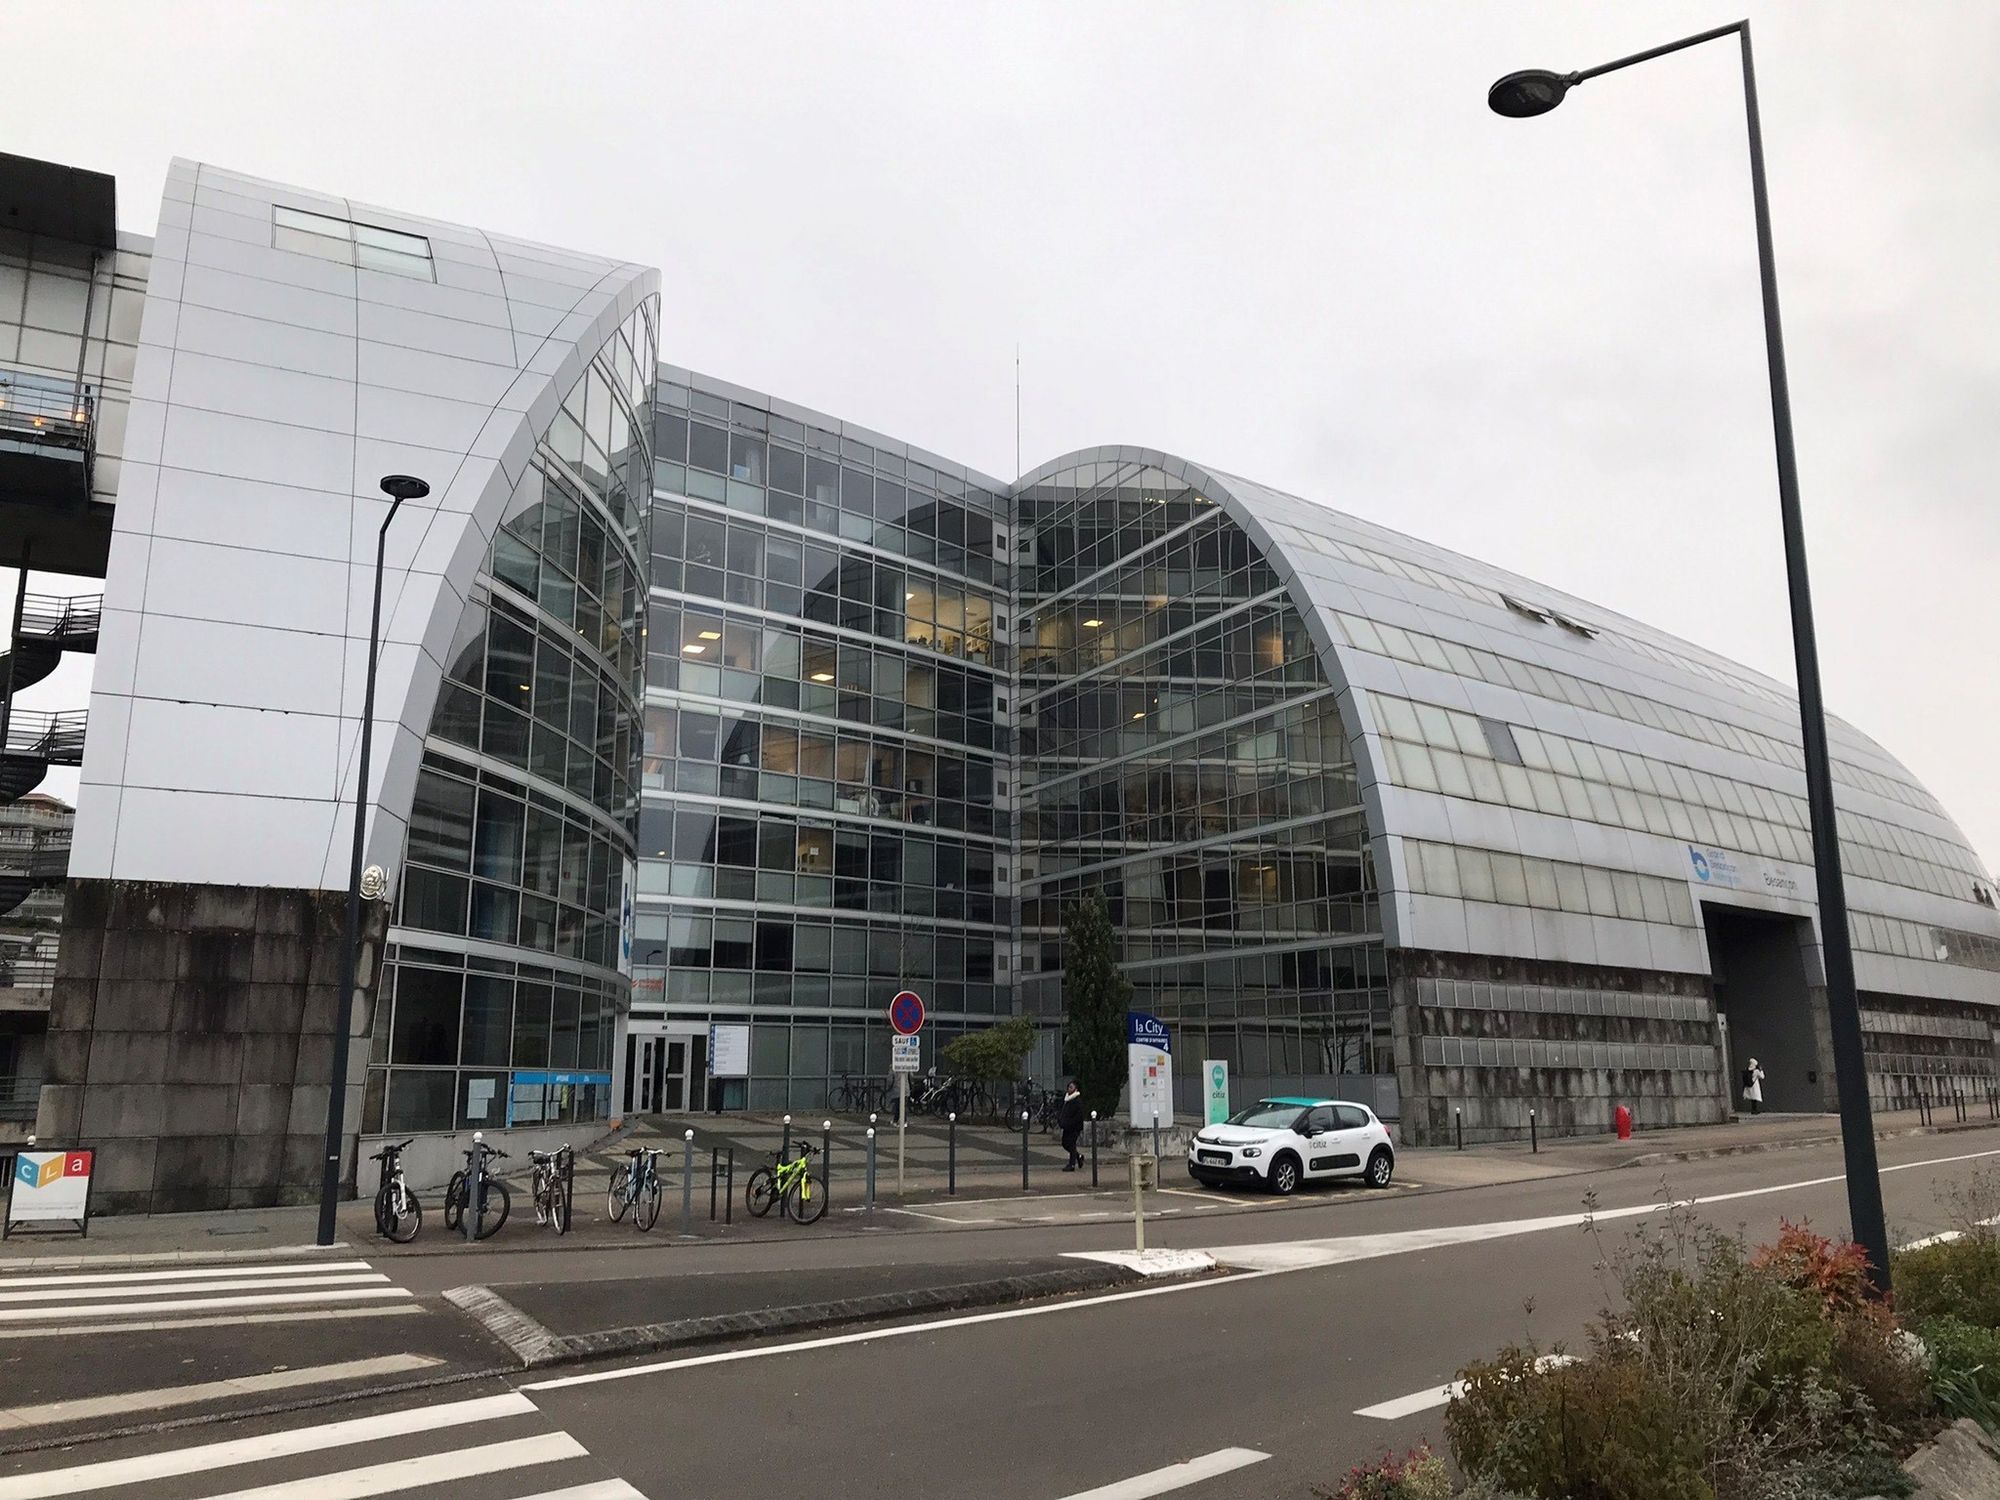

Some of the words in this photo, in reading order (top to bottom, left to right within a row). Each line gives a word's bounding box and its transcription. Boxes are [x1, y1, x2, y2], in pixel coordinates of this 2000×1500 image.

[1135, 1018, 1144, 1033] la
[1145, 1019, 1164, 1036] City
[894, 1037, 909, 1045] SAUF
[1212, 1090, 1226, 1099] citiz
[1313, 1140, 1327, 1149] citiz
